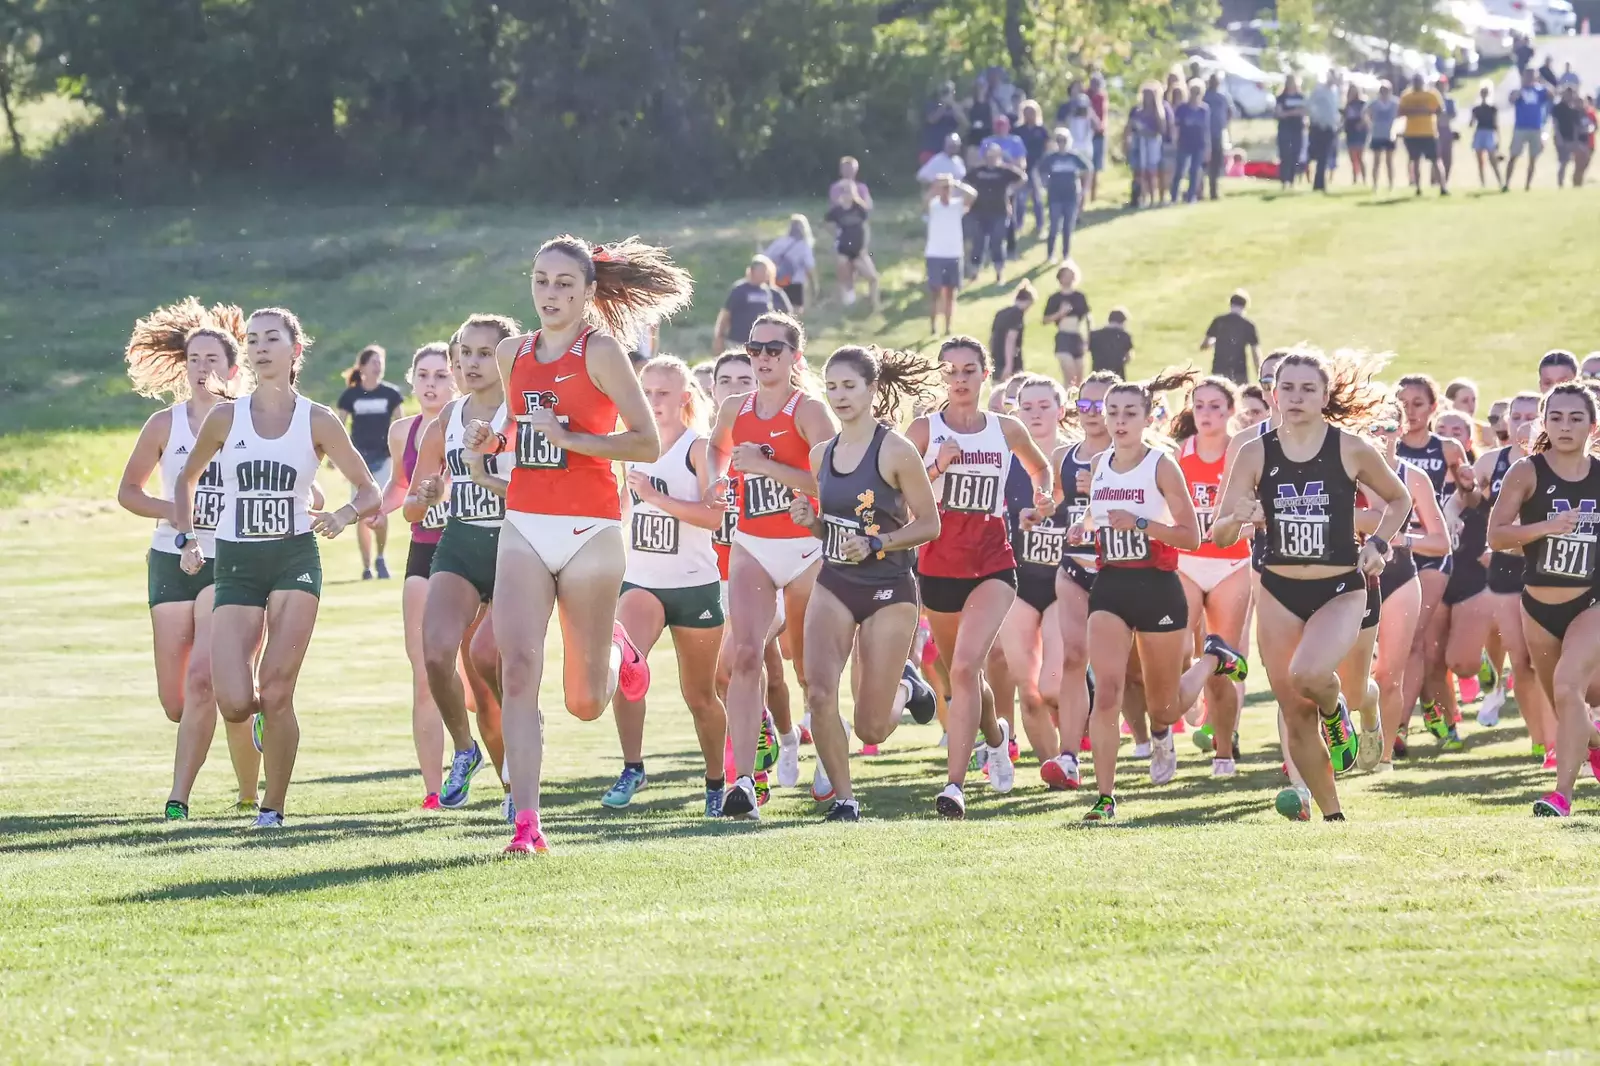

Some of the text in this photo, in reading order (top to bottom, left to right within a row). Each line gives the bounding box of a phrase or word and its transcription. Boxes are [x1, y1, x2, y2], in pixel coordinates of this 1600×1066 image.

[236, 460, 298, 492] OHIO
[947, 474, 994, 509] 1610
[456, 483, 501, 517] 1429
[747, 477, 791, 514] 1132
[242, 498, 290, 534] 1439
[636, 514, 675, 550] 1430
[1022, 530, 1064, 563] 1253
[1104, 527, 1147, 559] 1613
[1279, 521, 1326, 556] 1384
[1543, 538, 1589, 576] 1371
